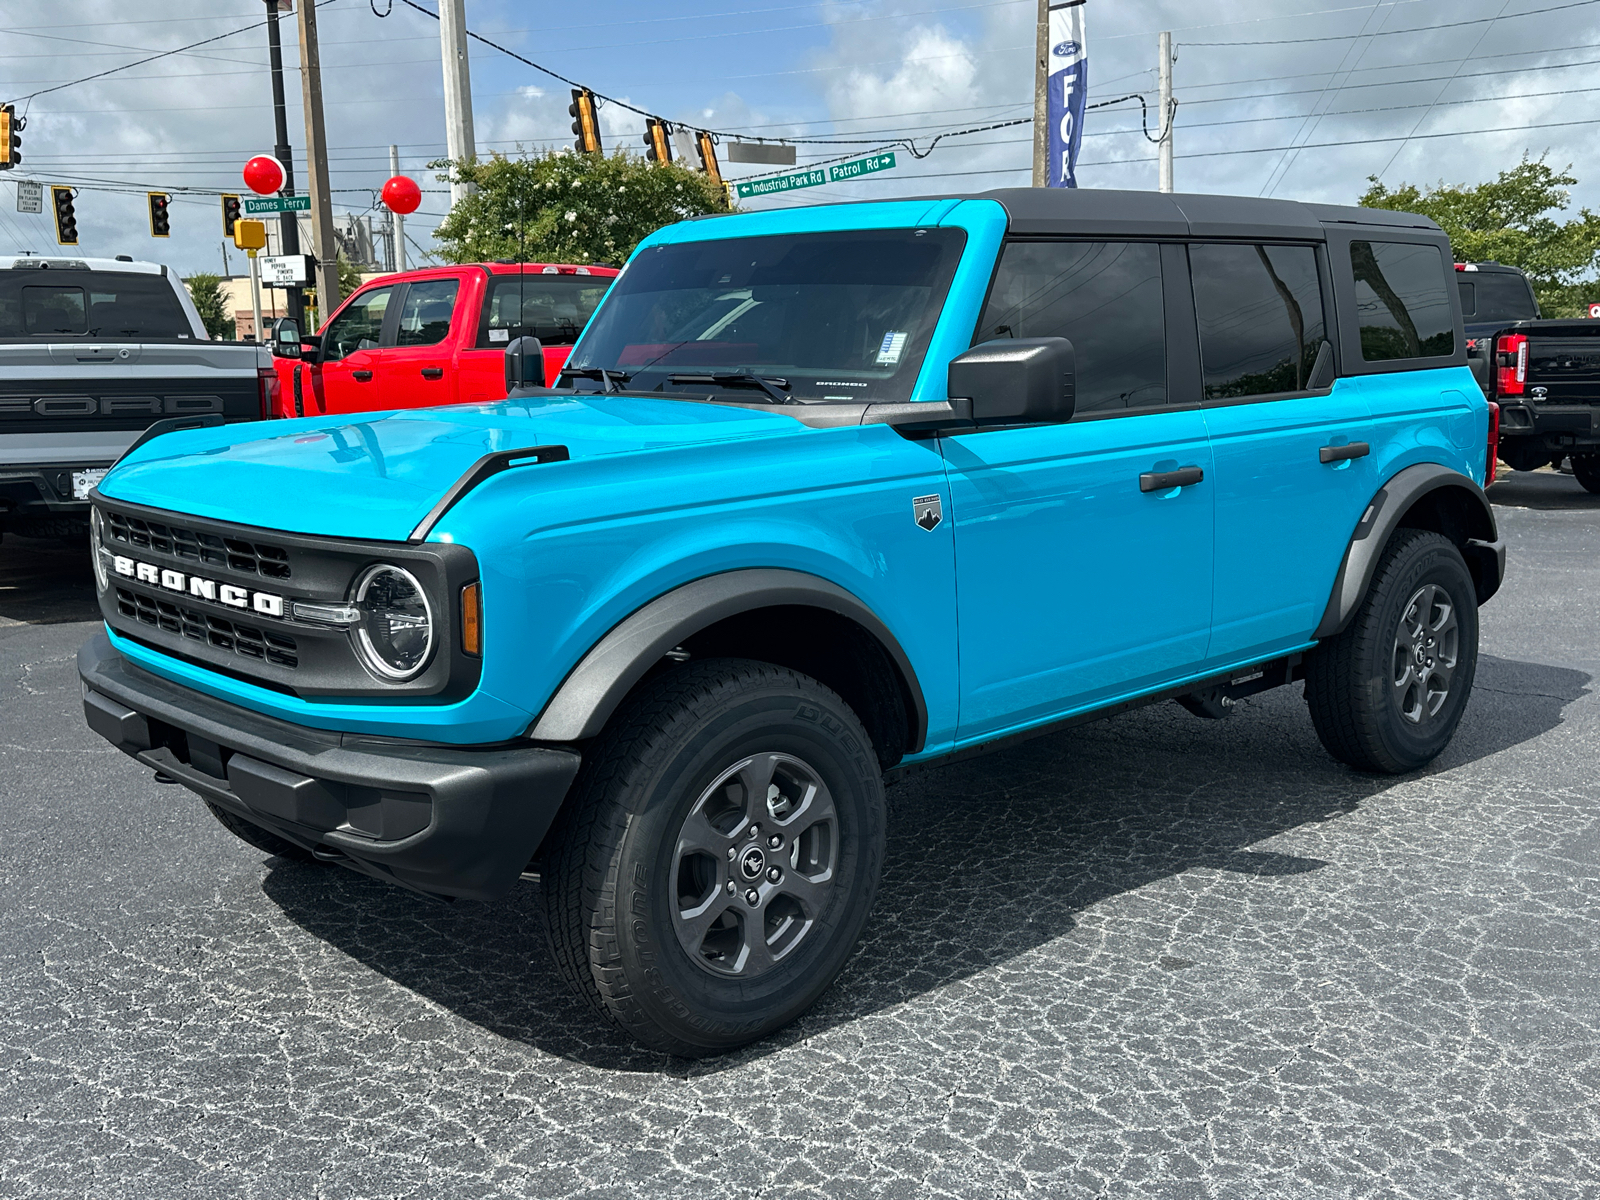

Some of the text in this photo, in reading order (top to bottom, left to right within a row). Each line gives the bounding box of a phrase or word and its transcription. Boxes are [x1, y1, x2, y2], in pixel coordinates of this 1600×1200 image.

[1060, 74, 1077, 187] FOR
[832, 156, 879, 180] Patrol Rd
[751, 172, 822, 194] Industrial Park Rd
[248, 199, 306, 211] Dames Ferry
[1466, 339, 1487, 348] X4
[114, 555, 284, 617] BRONCO
[630, 861, 768, 1036] BRIDGESTONE
